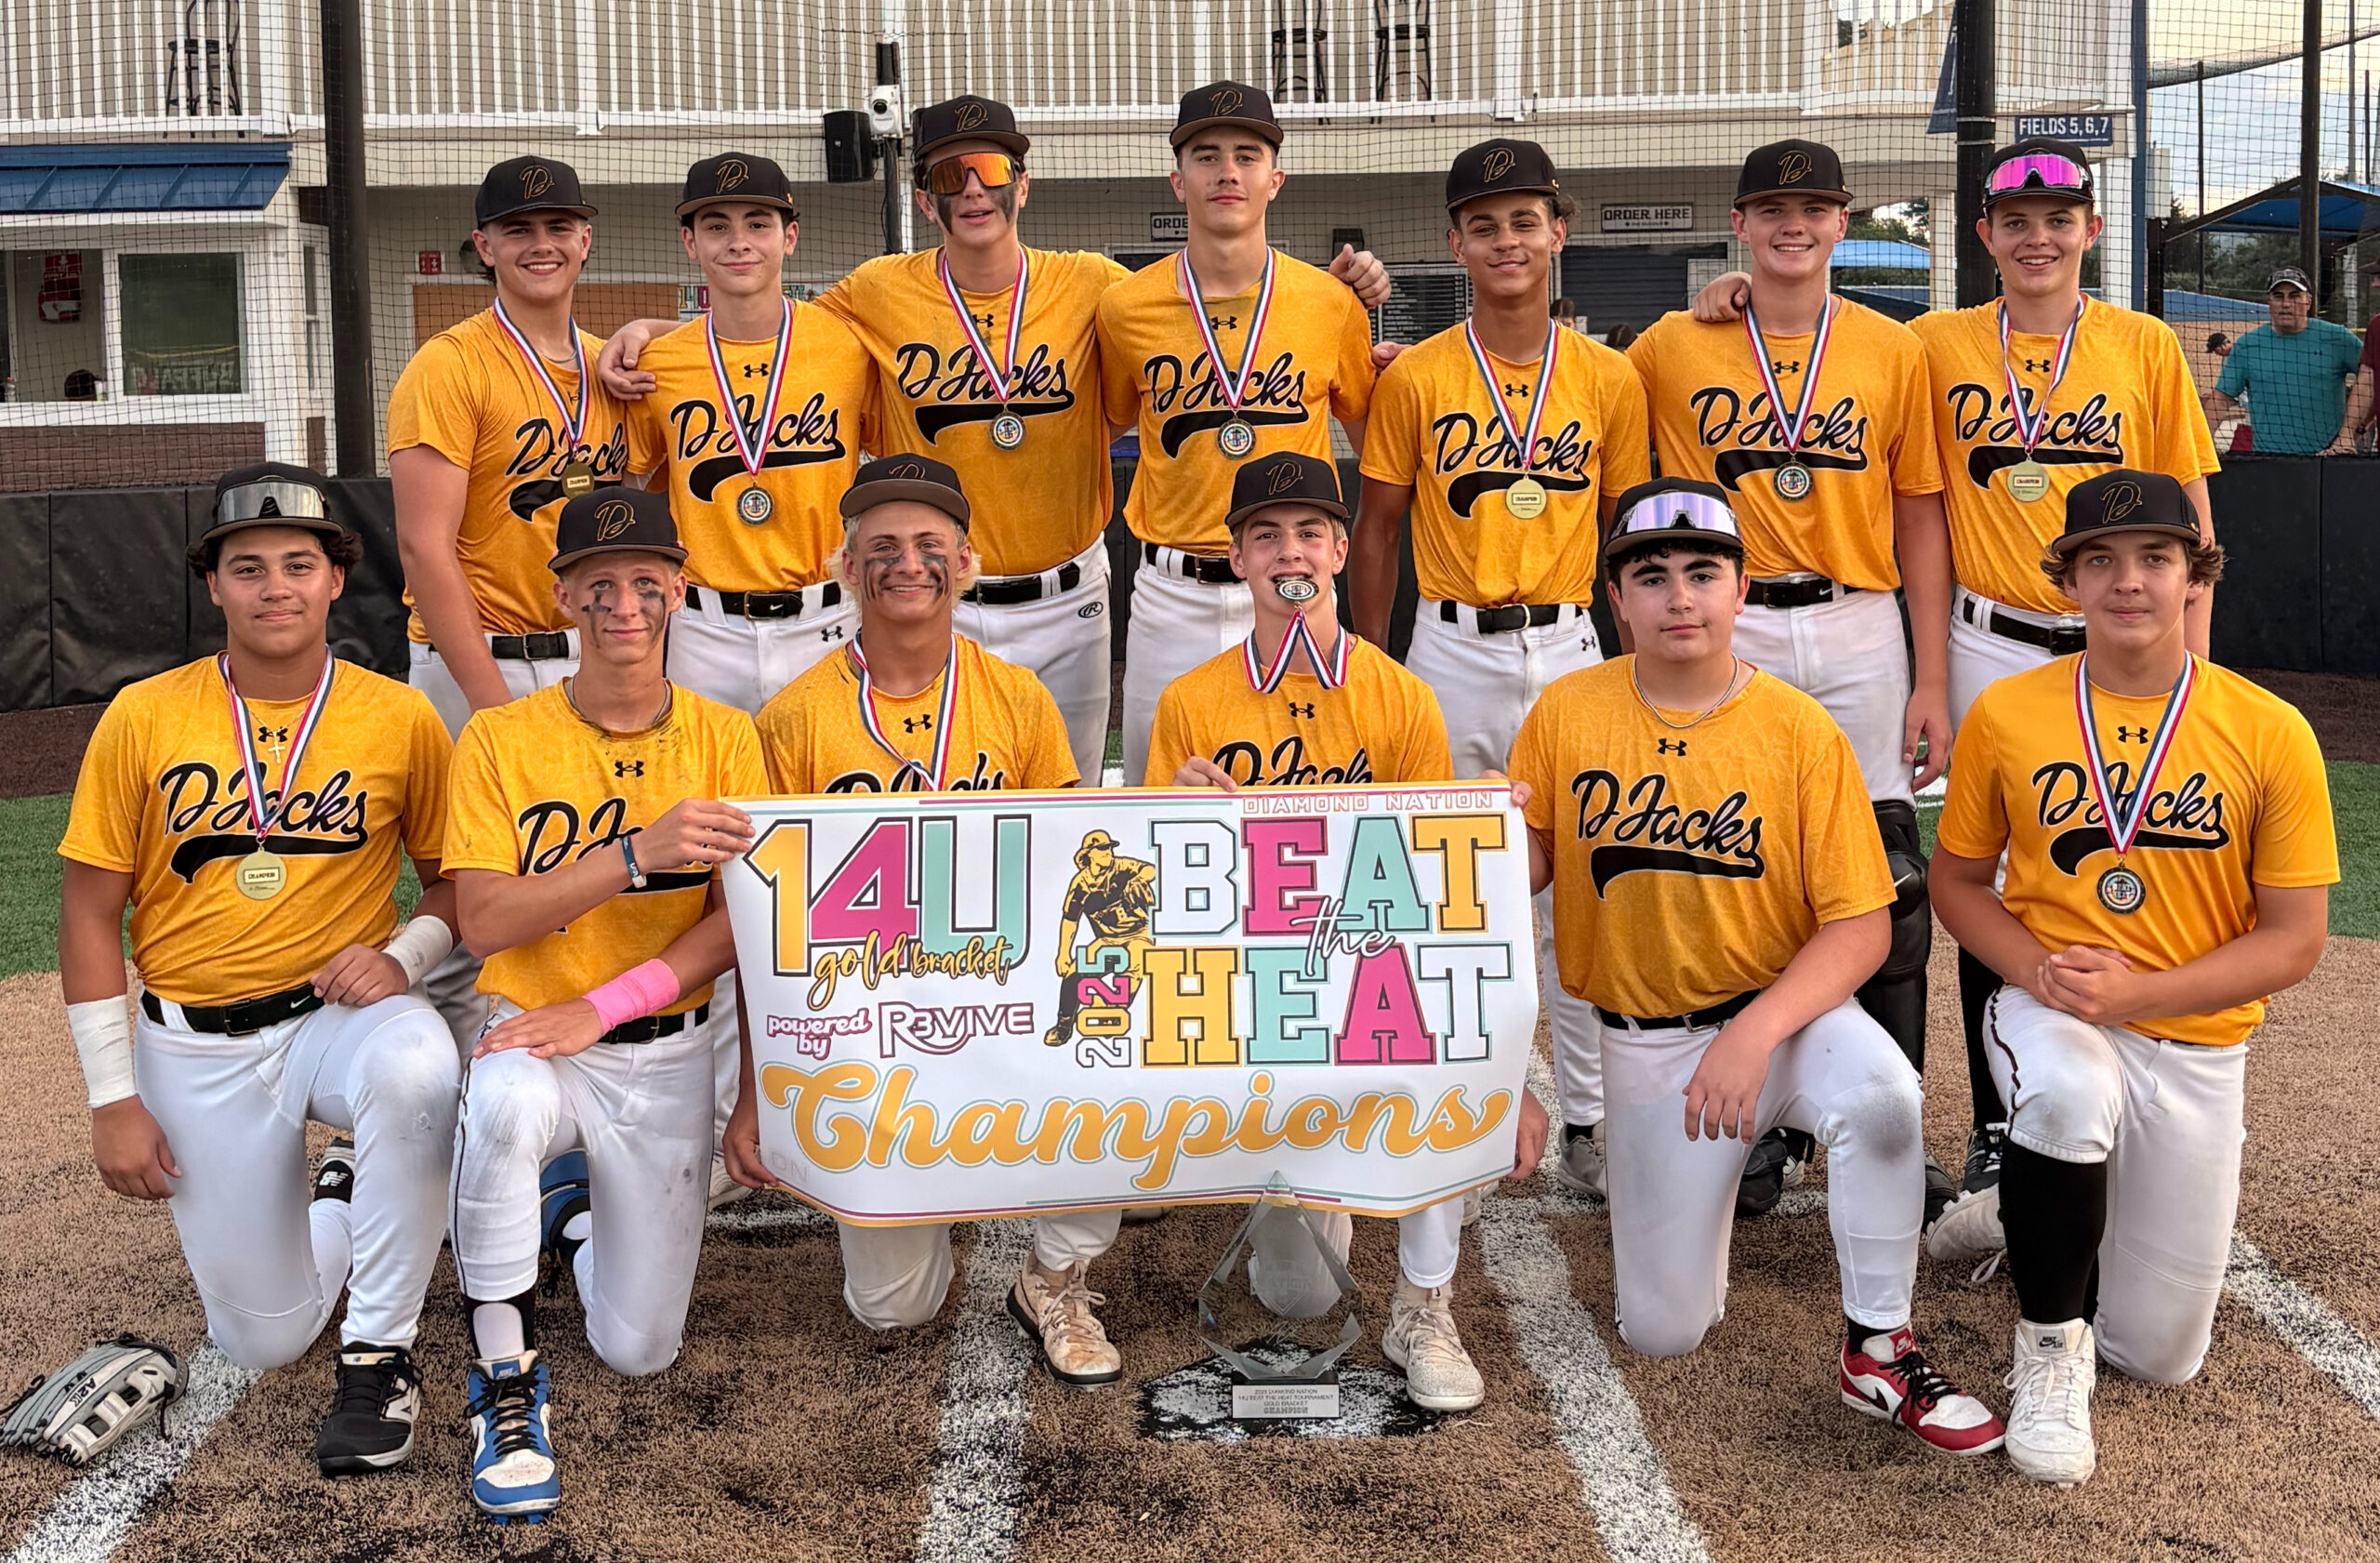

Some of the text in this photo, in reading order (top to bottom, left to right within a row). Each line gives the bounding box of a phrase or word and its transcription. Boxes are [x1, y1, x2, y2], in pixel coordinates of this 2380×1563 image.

[2019, 117, 2066, 136] FIELDS
[1154, 218, 1188, 229] ORDE
[1604, 208, 1690, 220] ORDER HERE
[505, 417, 628, 477] DJack
[669, 392, 842, 461] DJcks
[1944, 383, 2122, 453] DJcks
[1206, 735, 1372, 786] DJack
[2030, 761, 2225, 828] DJcks
[1243, 790, 1493, 815] DIAMOND NATION
[744, 815, 1031, 976] 14U
[1149, 813, 1508, 937] BEAT
[1290, 895, 1396, 976] the
[807, 931, 1014, 1012] gold bracket
[1141, 941, 1514, 1066] HEAT
[767, 1008, 872, 1038] powered
[1076, 945, 1132, 1068] 2025
[796, 1033, 831, 1060] by
[759, 1058, 1514, 1192] Champions
